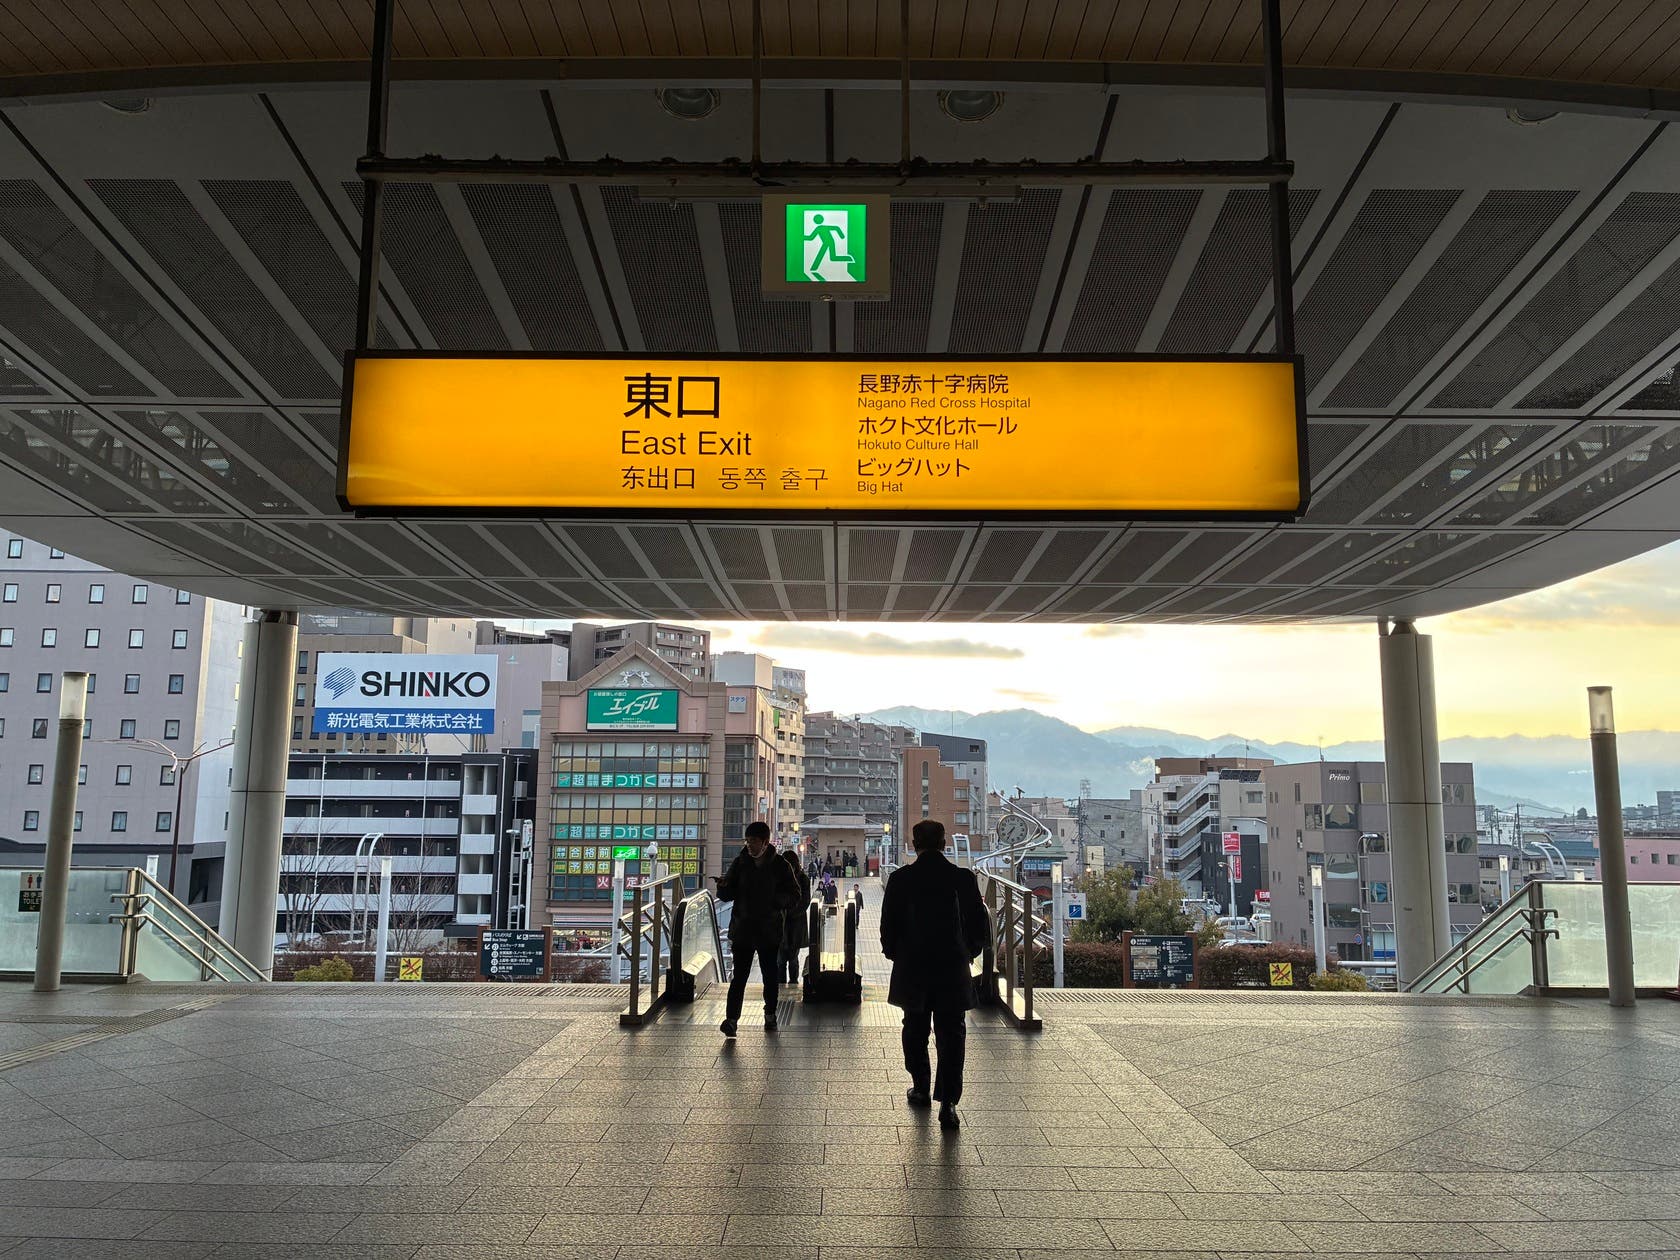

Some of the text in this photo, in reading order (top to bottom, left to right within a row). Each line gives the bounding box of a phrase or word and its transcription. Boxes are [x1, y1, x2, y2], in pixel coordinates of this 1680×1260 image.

[858, 373, 1009, 394] 長野赤十字病院
[623, 372, 721, 419] 東口
[857, 397, 1031, 410] Nagano Red Cross Hospital
[858, 416, 1018, 436] ホクト文化ホール
[621, 430, 752, 456] East Exit
[857, 439, 979, 450] Hokuto Culture Hall
[621, 465, 695, 490] 东出口
[857, 458, 971, 478] ビッグハット
[718, 467, 829, 491] 동쪽 출구
[857, 481, 904, 495] Big Hat
[360, 671, 490, 698] SHINKO
[602, 692, 663, 716] エイブル
[326, 712, 483, 729] 新光電気工業株式会社
[601, 774, 657, 787] まつがく
[1329, 773, 1351, 781] Primo
[600, 826, 656, 839] まつがく
